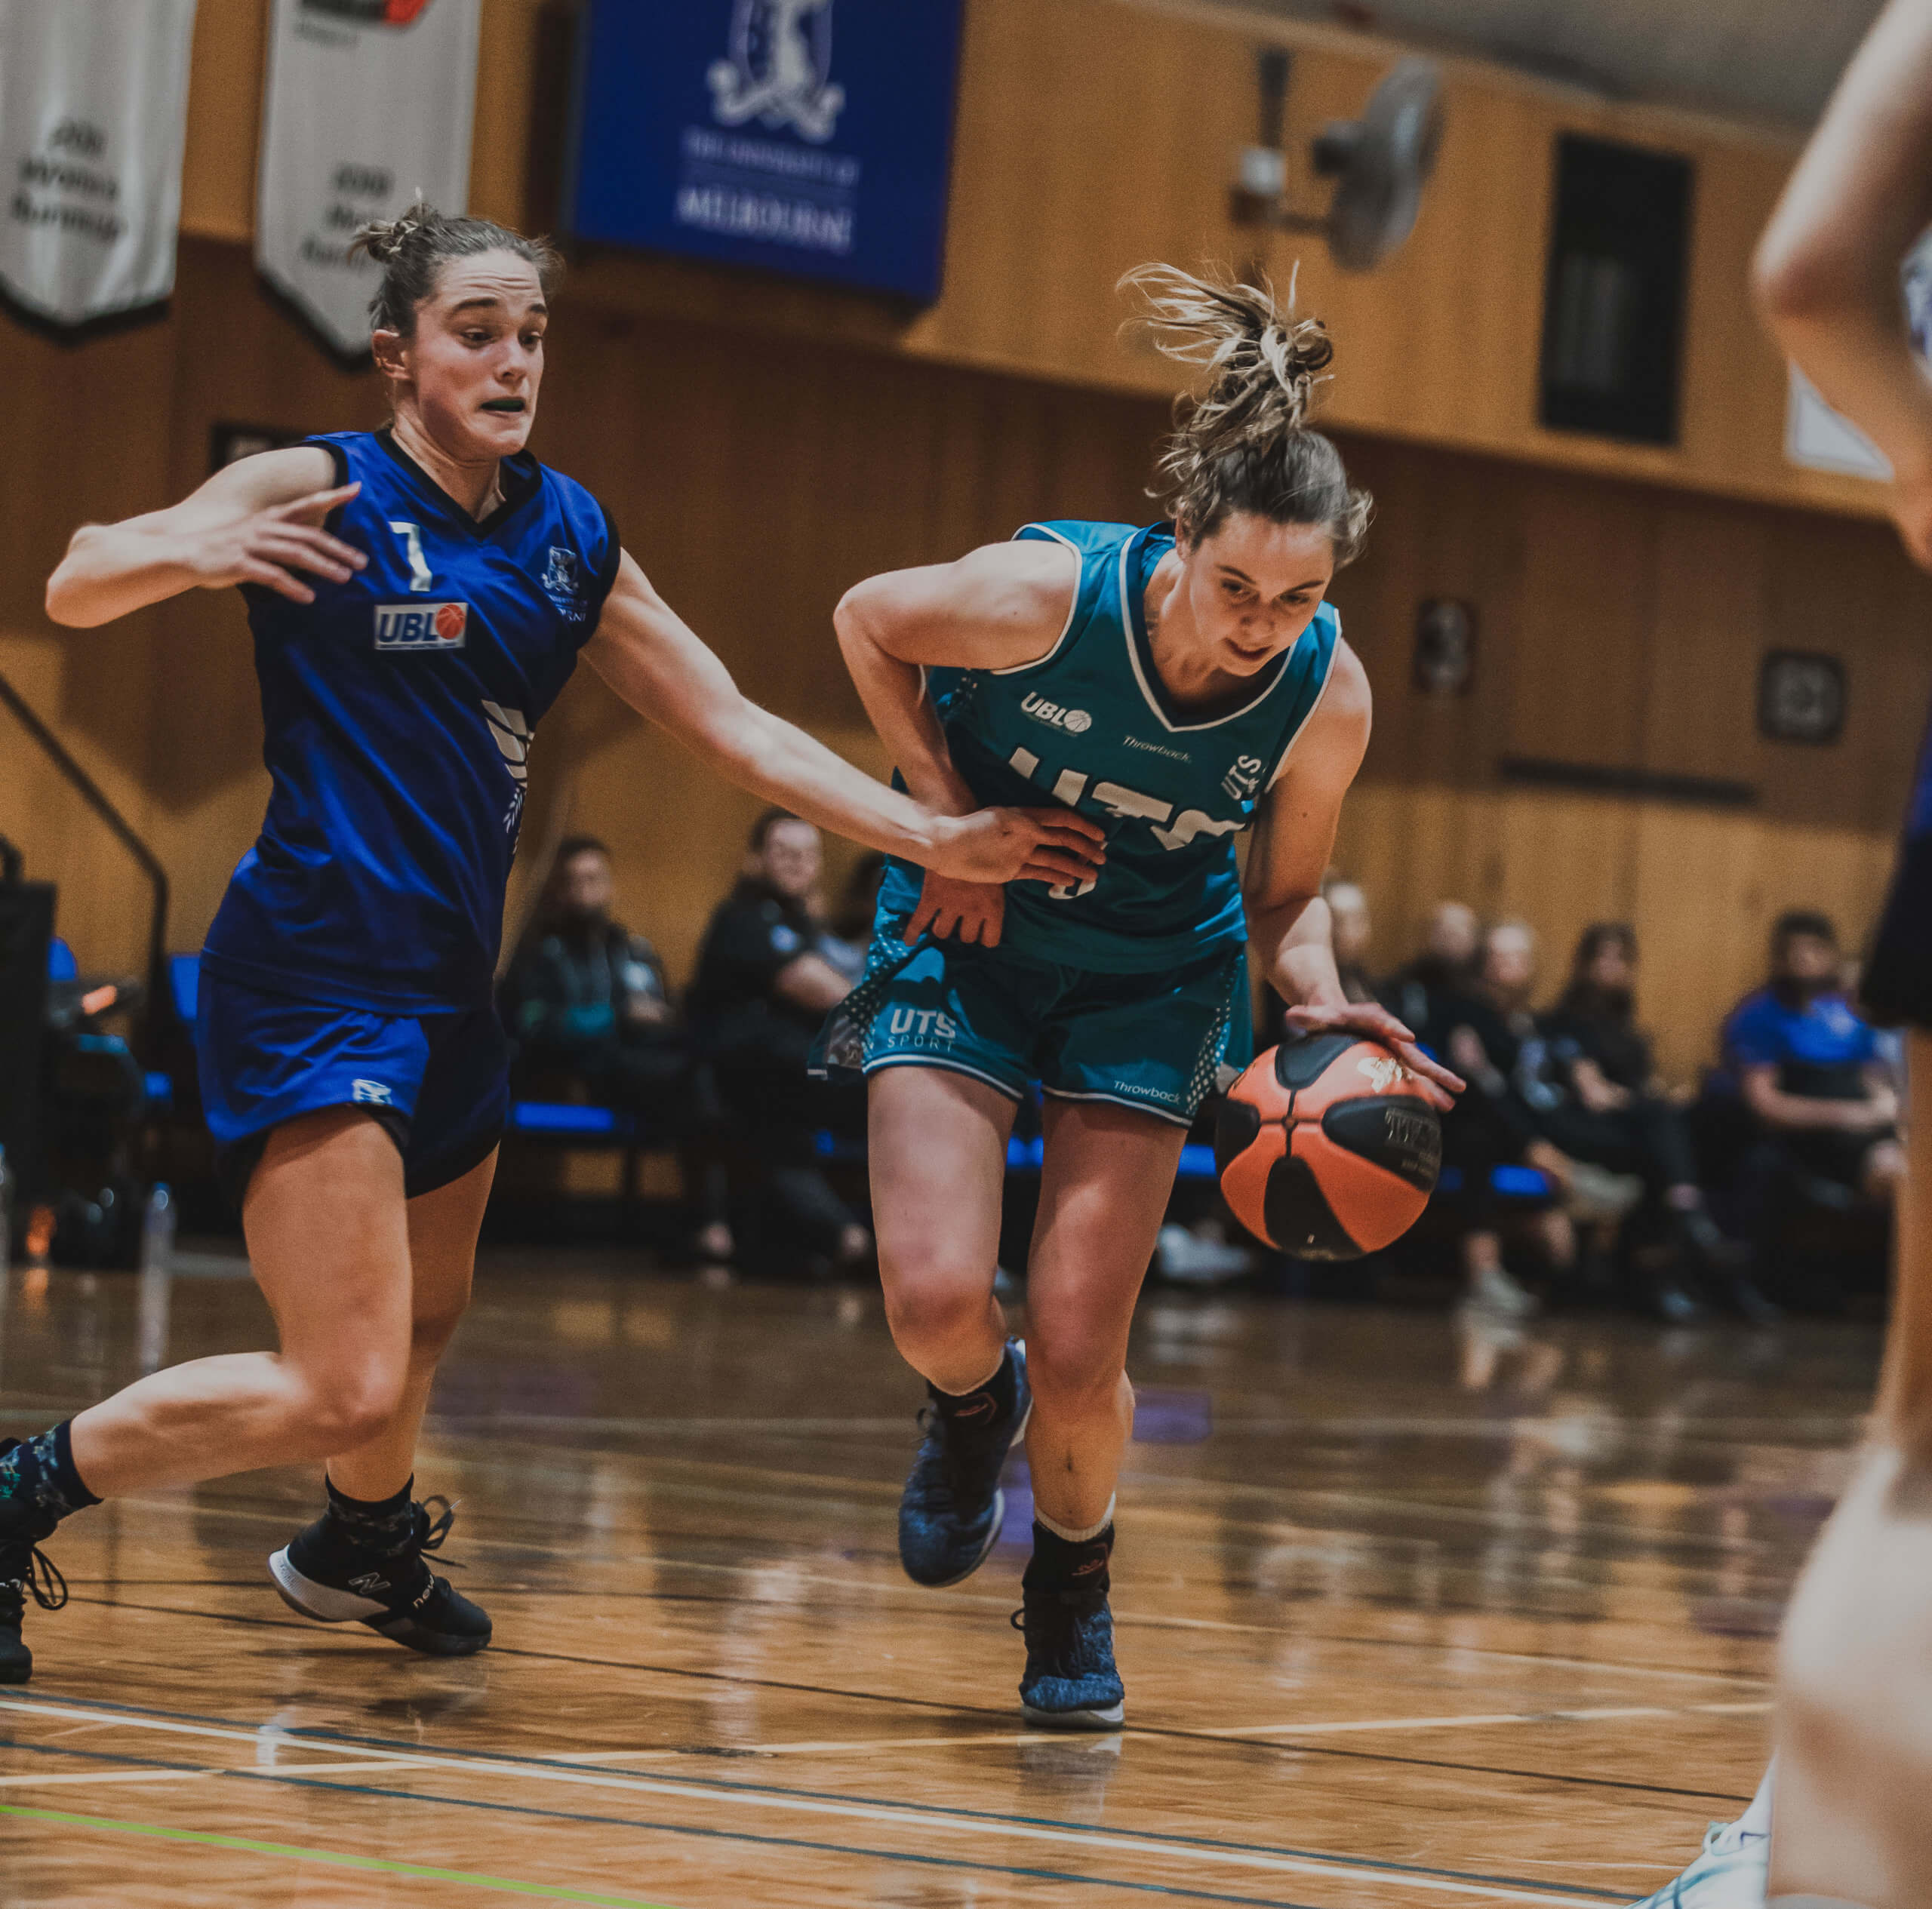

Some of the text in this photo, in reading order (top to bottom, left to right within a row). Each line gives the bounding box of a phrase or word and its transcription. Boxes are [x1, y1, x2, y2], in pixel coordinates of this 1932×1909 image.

[379, 612, 439, 643] UBL
[1020, 690, 1066, 727] UBL
[1220, 755, 1262, 800] UTS
[891, 1009, 956, 1038] UTS
[888, 1034, 955, 1053] SPORT
